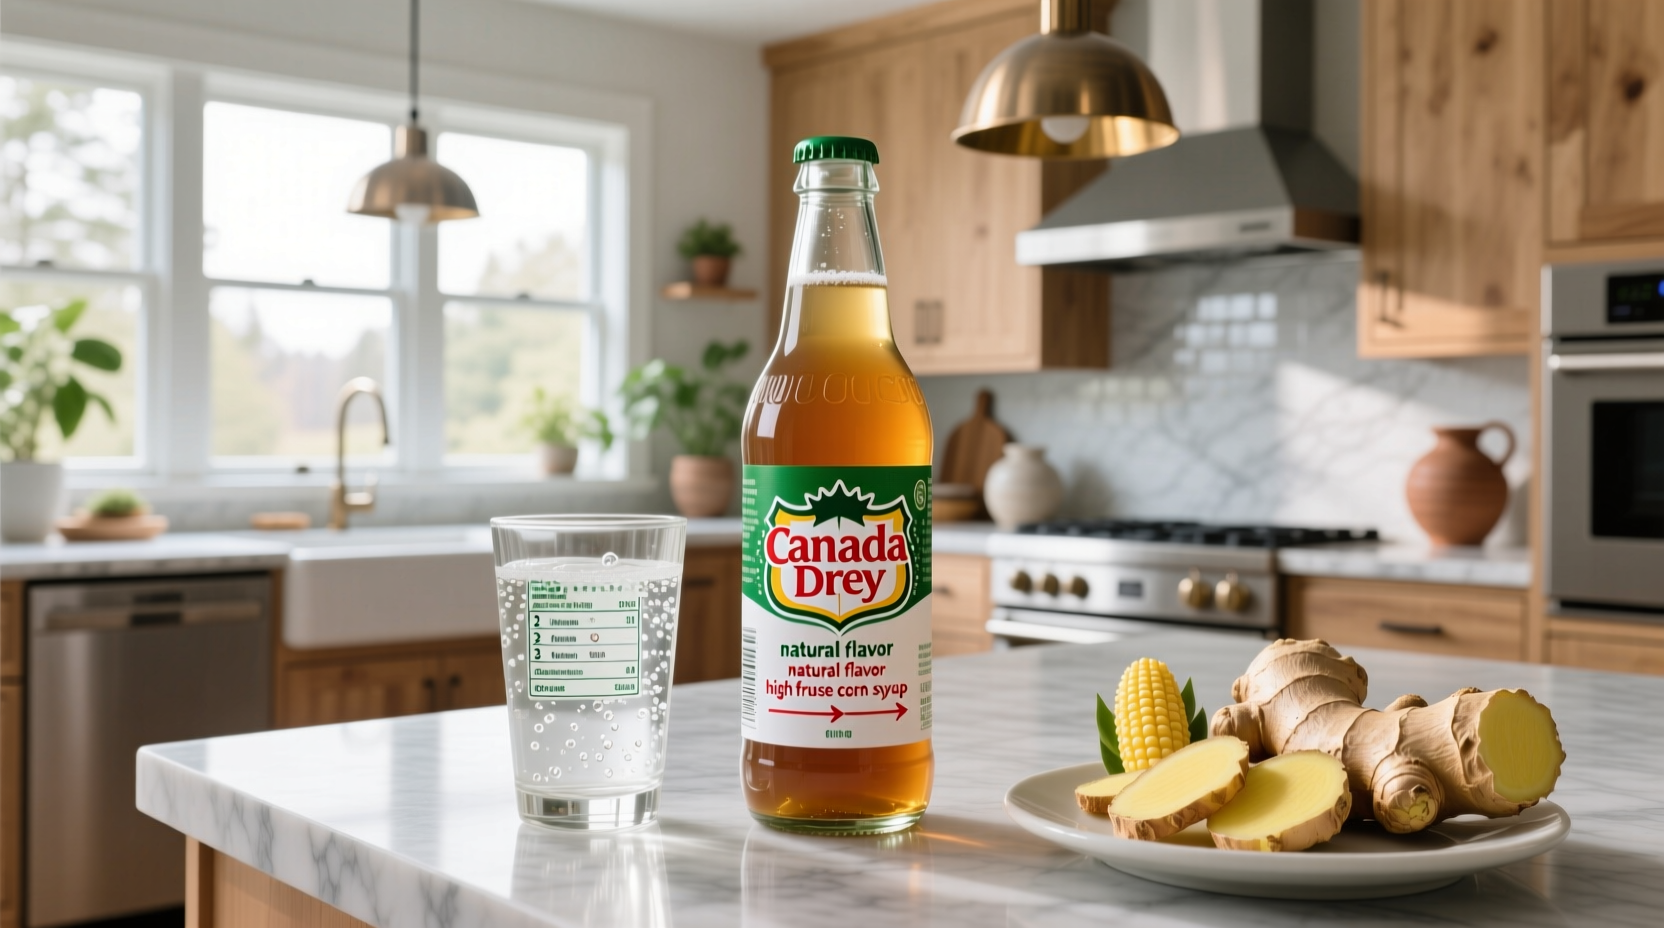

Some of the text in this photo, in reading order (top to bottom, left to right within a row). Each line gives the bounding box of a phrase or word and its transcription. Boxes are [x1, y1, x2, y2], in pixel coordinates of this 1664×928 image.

[766, 523, 909, 565] Canada
[793, 565, 886, 604] Drey
[780, 640, 894, 658] natural flavor
[788, 662, 886, 678] natural flavor
[766, 679, 793, 700] high
[796, 680, 834, 697] fruse
[837, 685, 869, 697] corn
